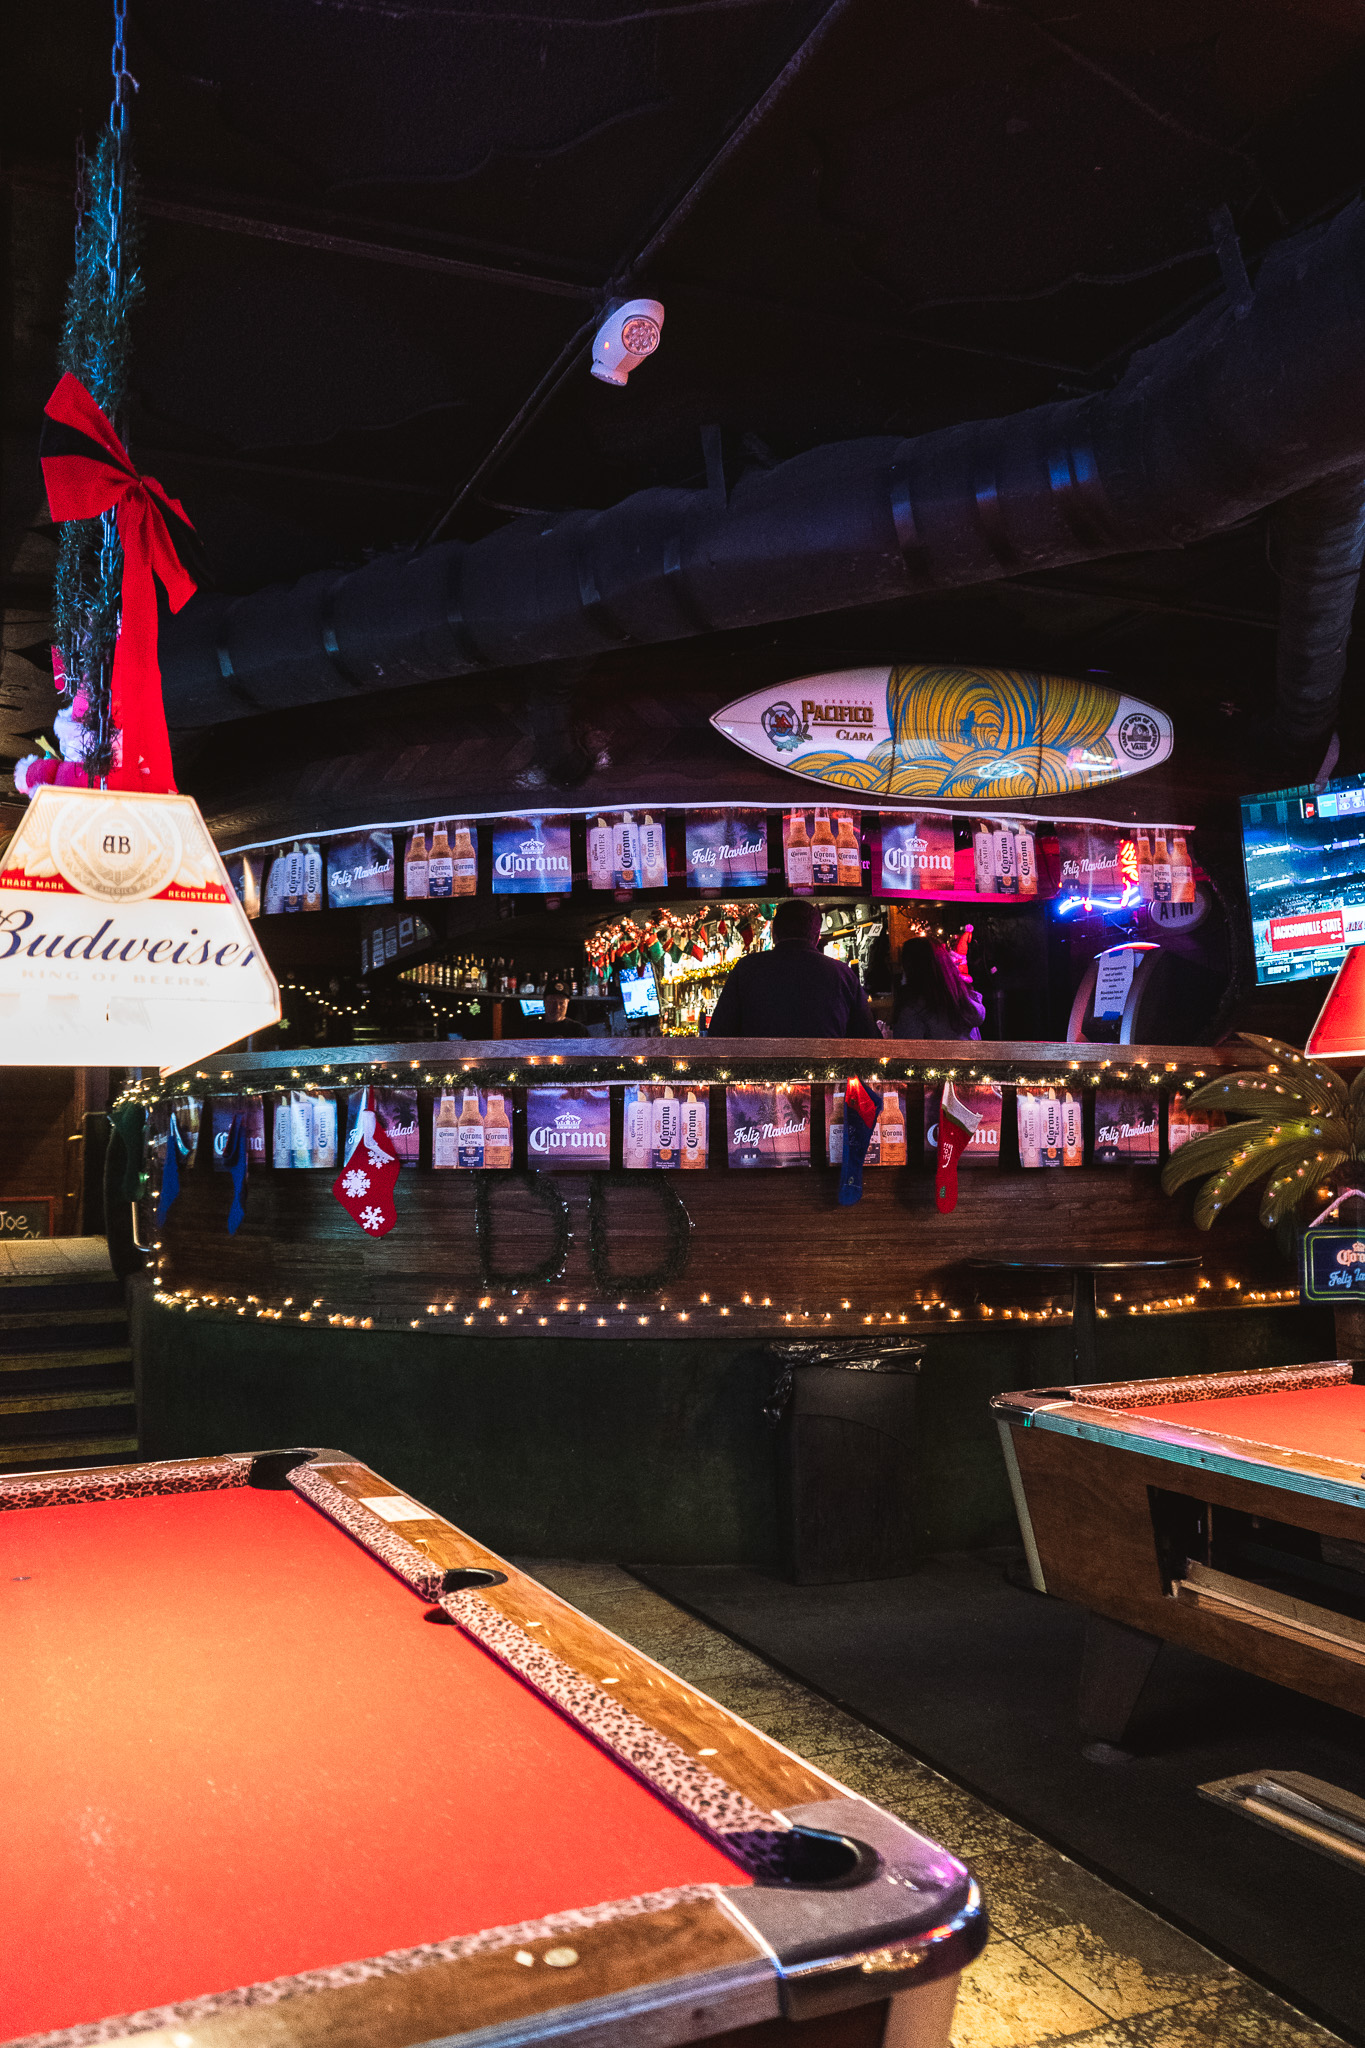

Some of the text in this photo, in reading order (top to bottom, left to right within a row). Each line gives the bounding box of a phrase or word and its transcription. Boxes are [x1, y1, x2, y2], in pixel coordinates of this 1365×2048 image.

[801, 700, 874, 723] PACIFICO
[824, 698, 873, 706] CERVEZA
[836, 729, 874, 742] CLARA
[1131, 742, 1148, 750] VANS
[102, 835, 132, 855] AB
[621, 830, 633, 868] Corona
[646, 830, 656, 867] Corona
[691, 838, 763, 867] Feliz Navidad
[813, 850, 836, 859] Corona
[838, 853, 858, 861] Corona
[1000, 837, 1011, 874] Corona
[495, 851, 569, 878] Corona
[884, 847, 952, 874] Corona
[1021, 841, 1031, 876] Corona
[1063, 854, 1119, 878] Feliz Navidad
[1, 878, 65, 890] TRADE MARK
[289, 858, 298, 894] Corona
[307, 859, 316, 893] Corona
[331, 870, 352, 887] Feliz
[353, 859, 391, 881] Navidad
[168, 889, 228, 901] REGISTERED
[0, 908, 256, 967] Budweiser
[1273, 917, 1342, 941] JACKSONVILLE STATE
[22, 969, 80, 982] KING
[91, 971, 118, 983] OF
[1267, 965, 1291, 975] ESPN
[318, 1111, 328, 1148] Corona
[385, 1120, 415, 1138] vidad
[460, 1132, 482, 1141] Corona
[485, 1132, 508, 1141] Corona
[636, 1109, 644, 1148] PREMIER
[659, 1106, 672, 1147] Corona
[686, 1109, 699, 1148] Corona
[733, 1118, 806, 1146] Feliz Navidad
[881, 1129, 903, 1138] Corona
[1047, 1106, 1056, 1146] Corona
[1067, 1109, 1076, 1146] Corona
[1098, 1119, 1155, 1145] Feliz Navidad
[529, 1126, 607, 1154] Corona
[1328, 1270, 1353, 1288] Feliz
